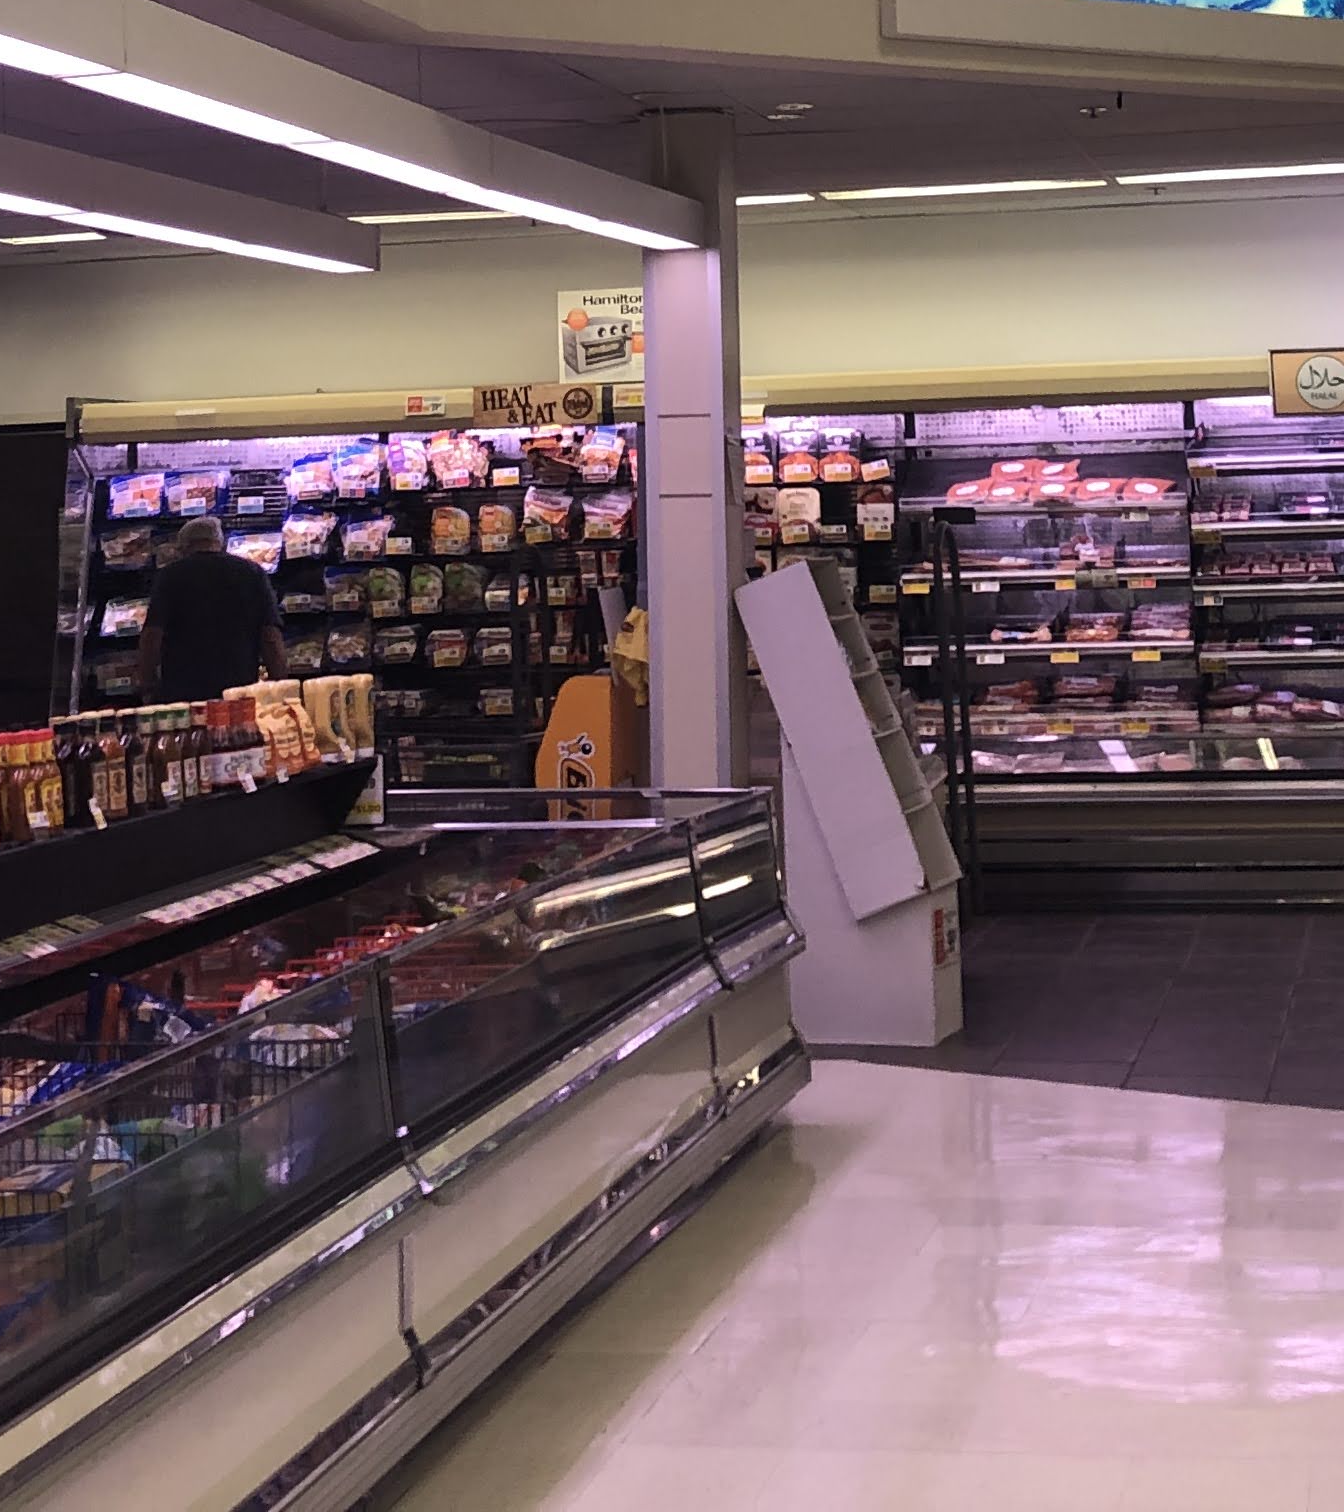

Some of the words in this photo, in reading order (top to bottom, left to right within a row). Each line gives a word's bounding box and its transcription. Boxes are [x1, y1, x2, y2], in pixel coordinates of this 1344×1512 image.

[481, 385, 533, 412] HEAT
[1310, 391, 1338, 400] HALAL
[507, 405, 520, 424] &
[521, 400, 557, 425] EAT
